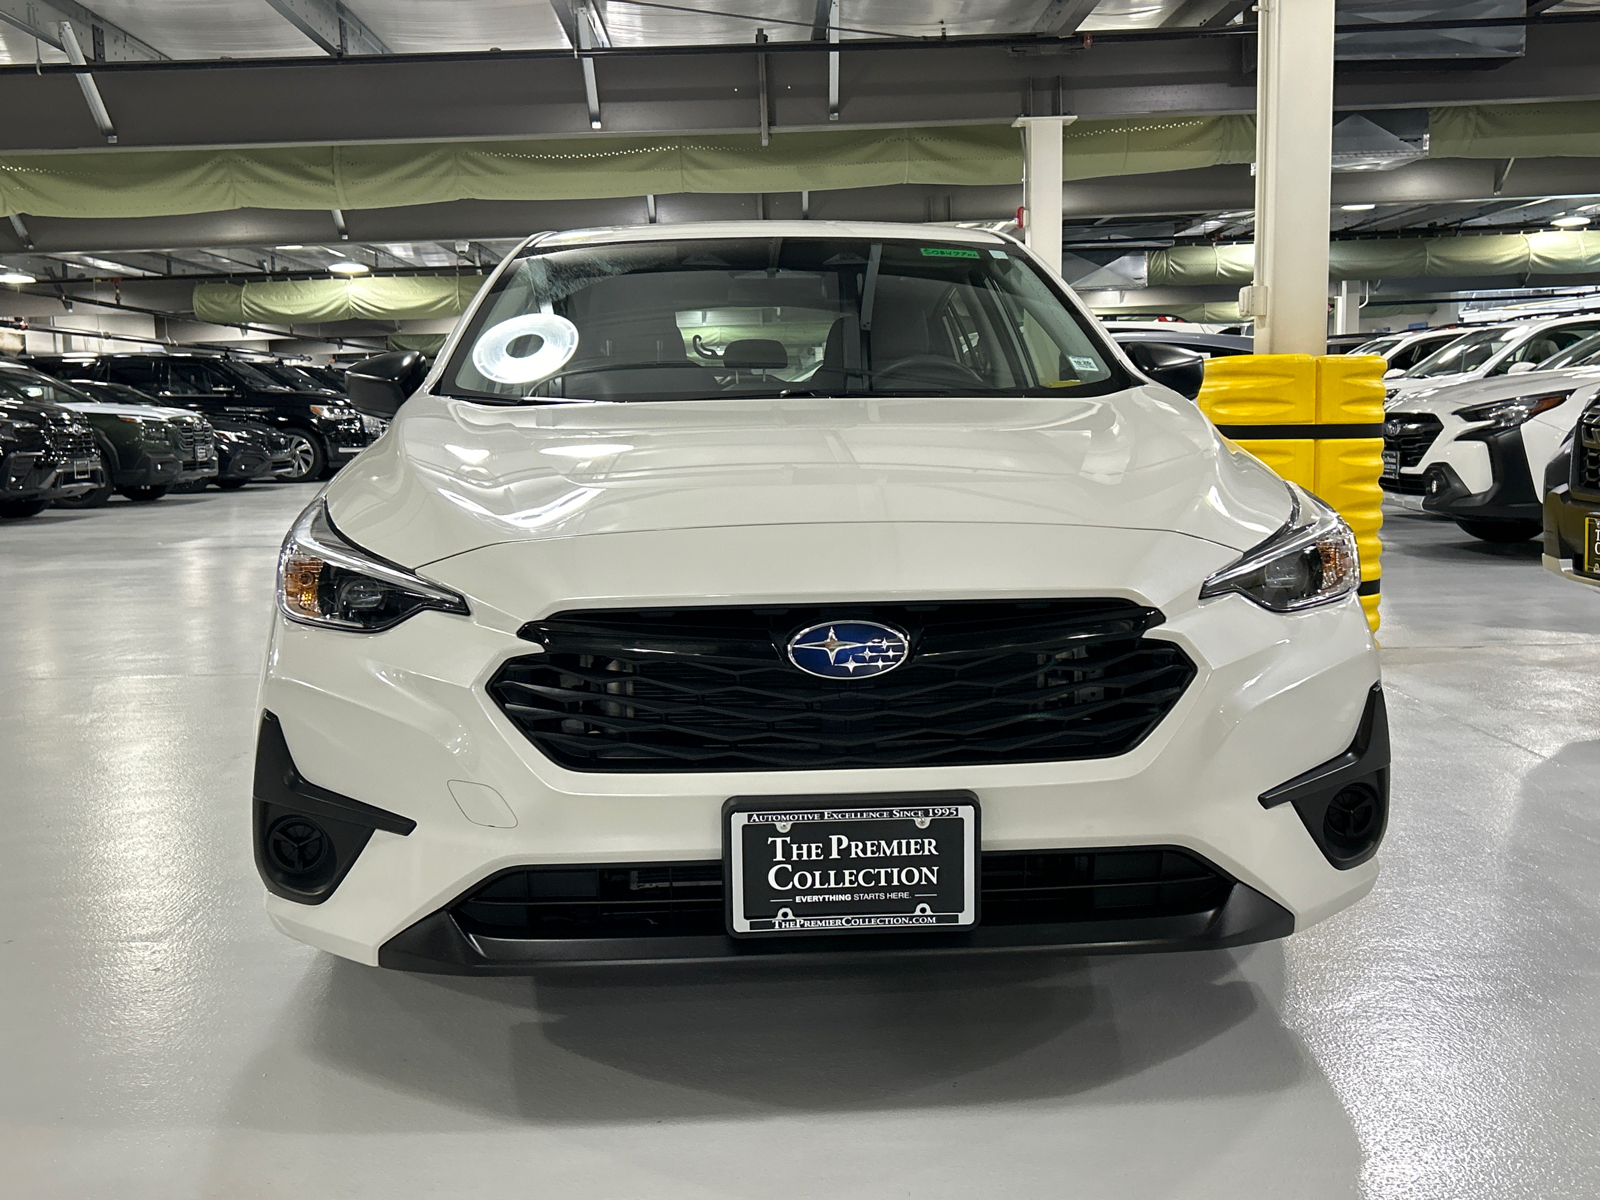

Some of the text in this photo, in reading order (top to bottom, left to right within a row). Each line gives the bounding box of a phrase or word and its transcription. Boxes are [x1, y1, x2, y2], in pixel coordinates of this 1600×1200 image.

[750, 807, 957, 823] AUTOMOTIVE EXCELLENCE SINCE 1995
[767, 834, 939, 862] THE PREMIER
[767, 863, 939, 891] COLLECTION
[795, 891, 912, 903] EVERYTHING STARTS HERE.
[772, 916, 937, 929] THEPREMIERCOLLECTION.COM
